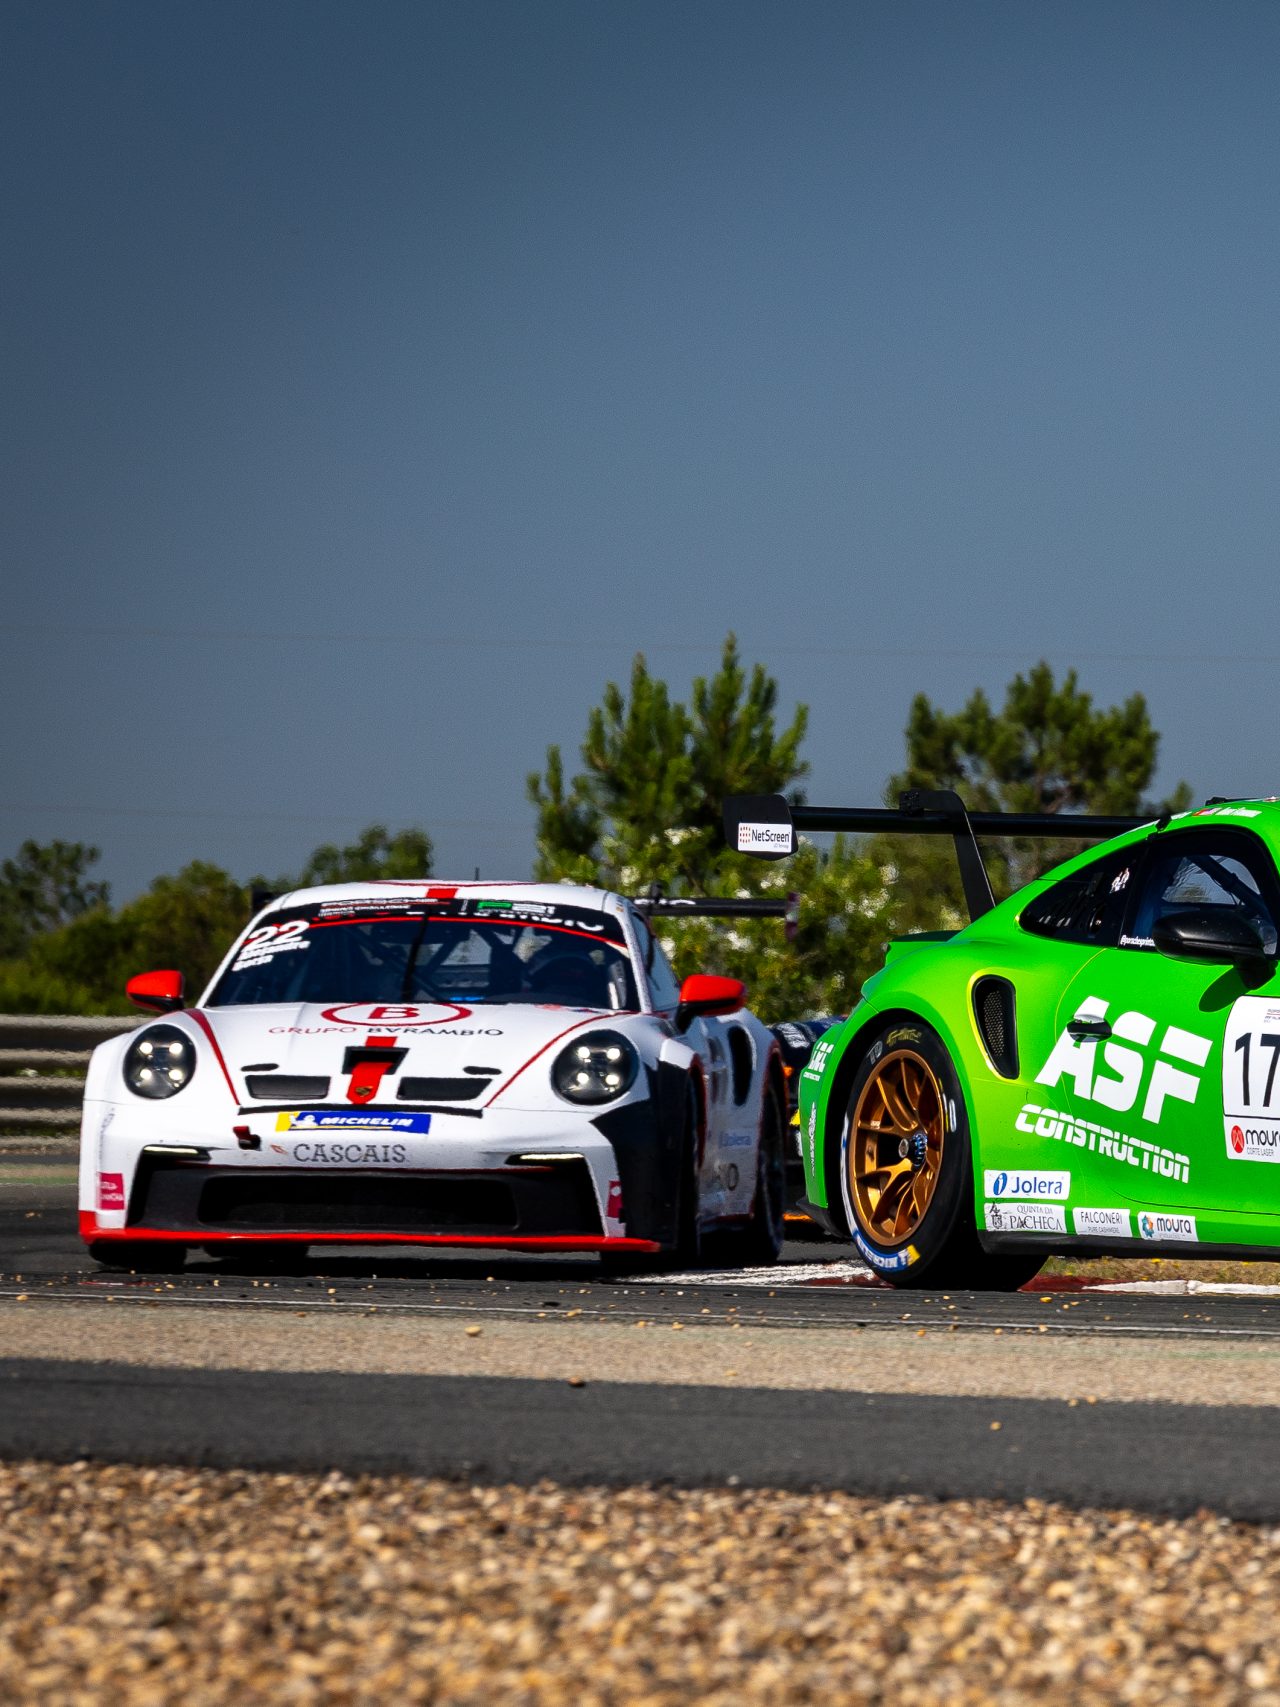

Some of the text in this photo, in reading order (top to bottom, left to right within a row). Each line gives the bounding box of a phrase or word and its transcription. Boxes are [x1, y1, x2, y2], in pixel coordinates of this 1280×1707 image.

[752, 829, 790, 843] NetScreen
[241, 920, 310, 953] 22
[368, 1007, 420, 1019] B
[269, 1026, 357, 1035] GRUPO
[1034, 995, 1213, 1125] ASF
[320, 1116, 414, 1127] MICHELIN
[1015, 1103, 1190, 1184] CONSTRUCTION
[293, 1143, 407, 1163] CASCAIS
[1011, 1176, 1063, 1195] Jolera
[1017, 1204, 1053, 1214] QUINTA DA
[1010, 1215, 1063, 1231] PACHECA
[1081, 1211, 1123, 1225] FALCONERI
[1157, 1217, 1192, 1234] moura
